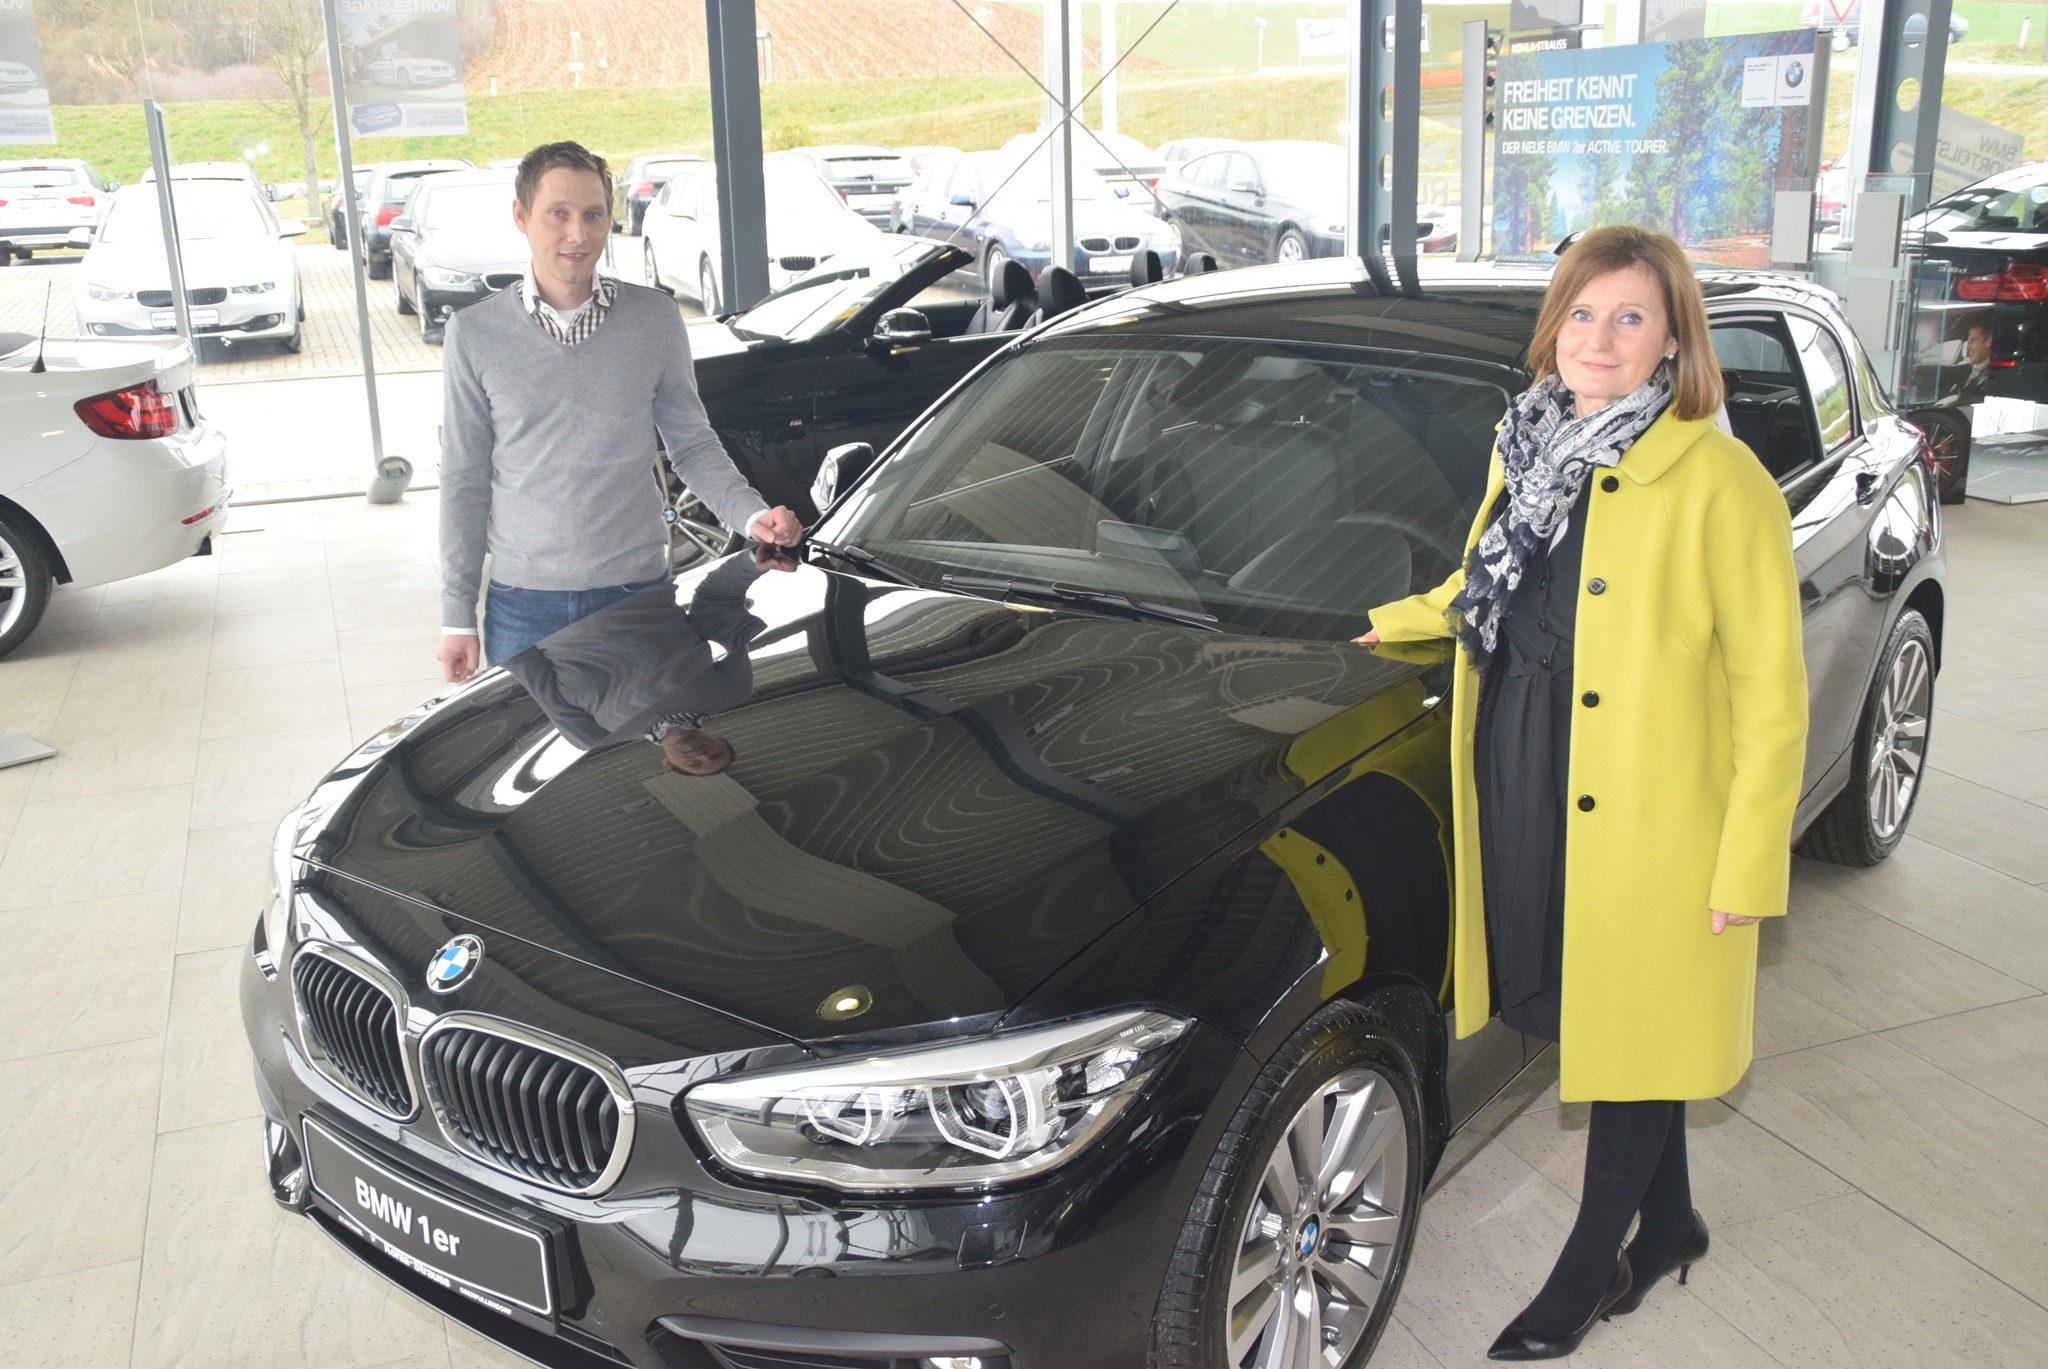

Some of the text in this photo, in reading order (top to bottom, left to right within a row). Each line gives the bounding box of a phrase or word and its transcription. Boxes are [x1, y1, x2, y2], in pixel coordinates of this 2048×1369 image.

[1511, 38, 1567, 54] KOHLA-STRAUSS
[1503, 74, 1637, 104] FREIHEIT KENNT
[1502, 104, 1636, 131] KEINE GRENZEN.
[1502, 139, 1668, 154] DER NEUE BMW 2er ACTIVE TOURER.
[354, 1175, 461, 1256] BMW 1er
[383, 1243, 451, 1288] Kohla-Strauss
